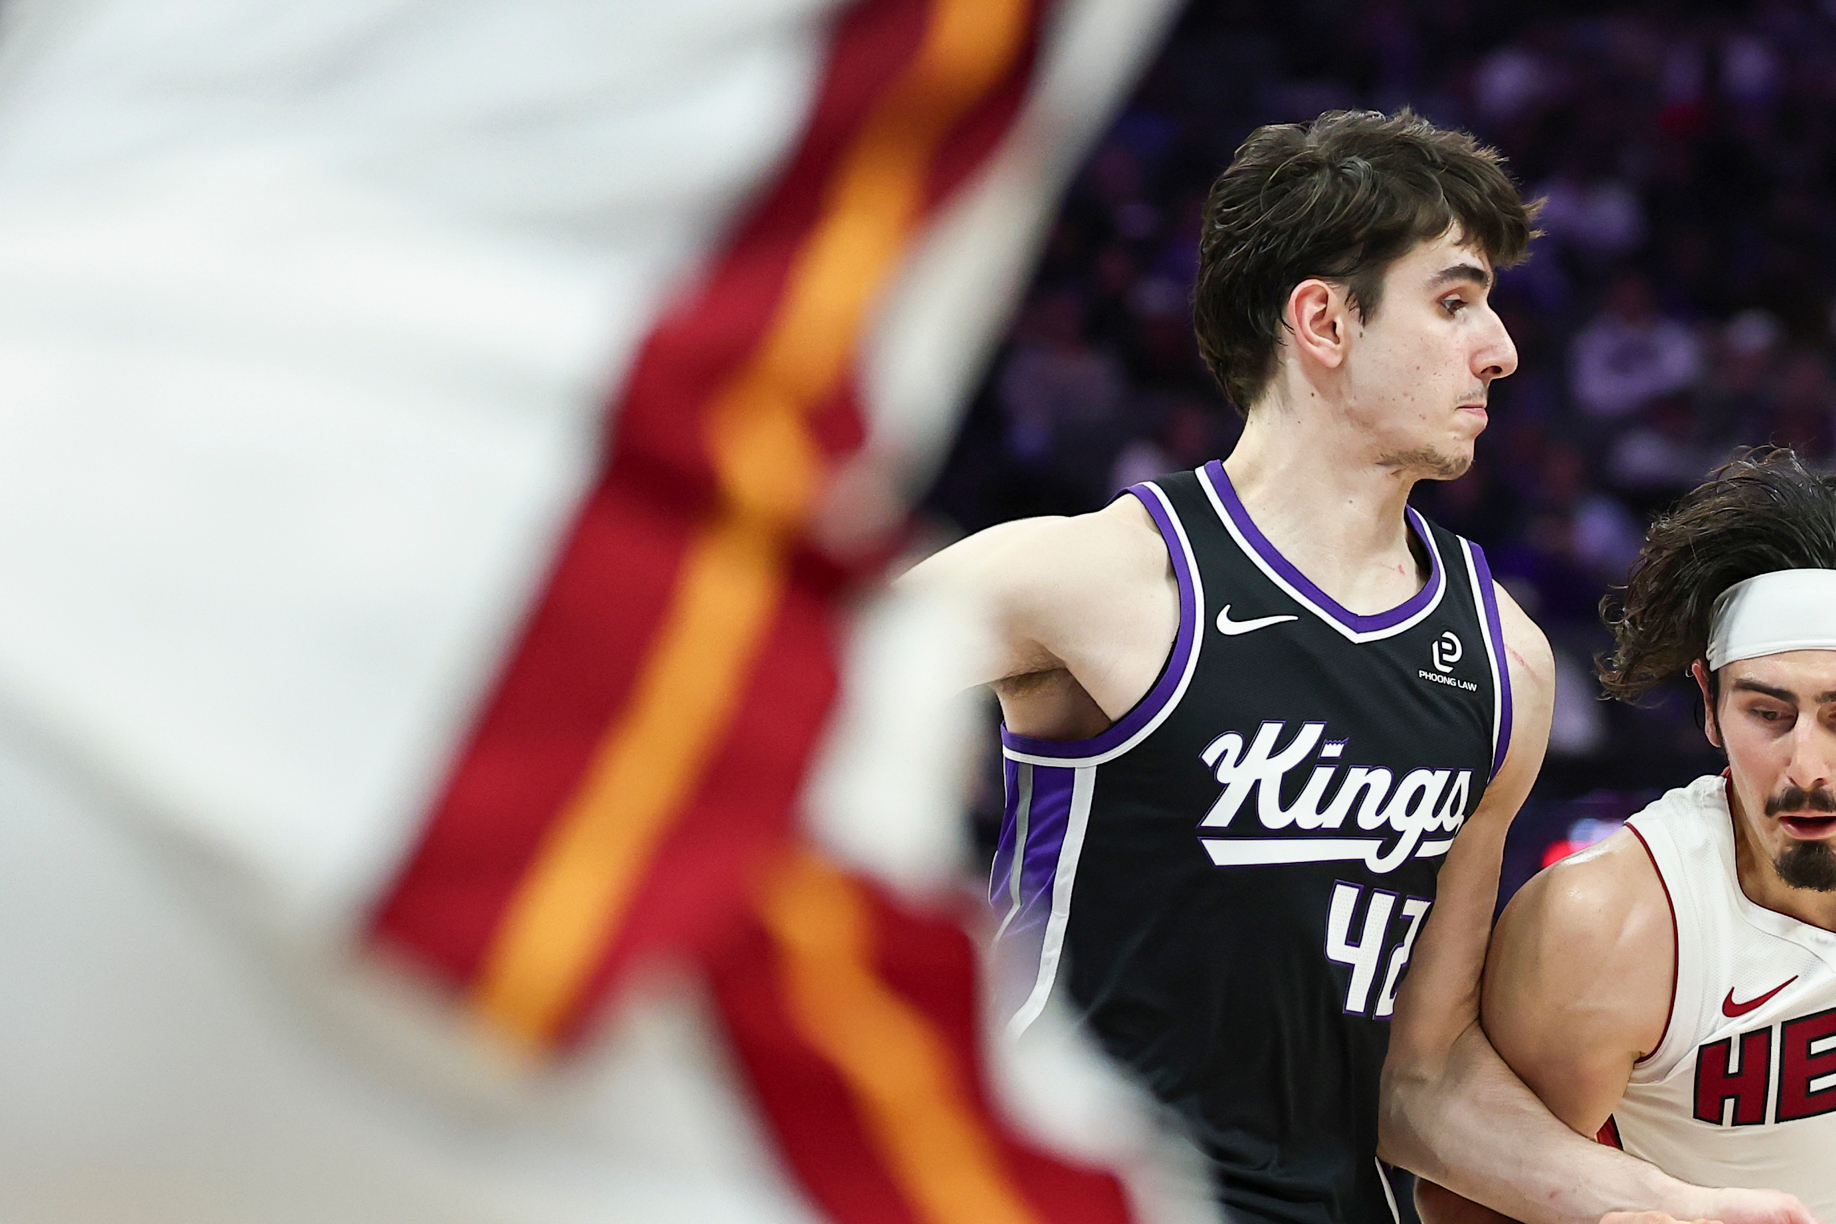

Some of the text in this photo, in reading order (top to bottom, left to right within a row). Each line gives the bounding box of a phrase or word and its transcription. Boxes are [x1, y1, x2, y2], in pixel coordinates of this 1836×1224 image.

[1418, 669, 1478, 692] PHOONG LAW
[1198, 720, 1473, 873] Kings
[1325, 880, 1432, 1019] 42
